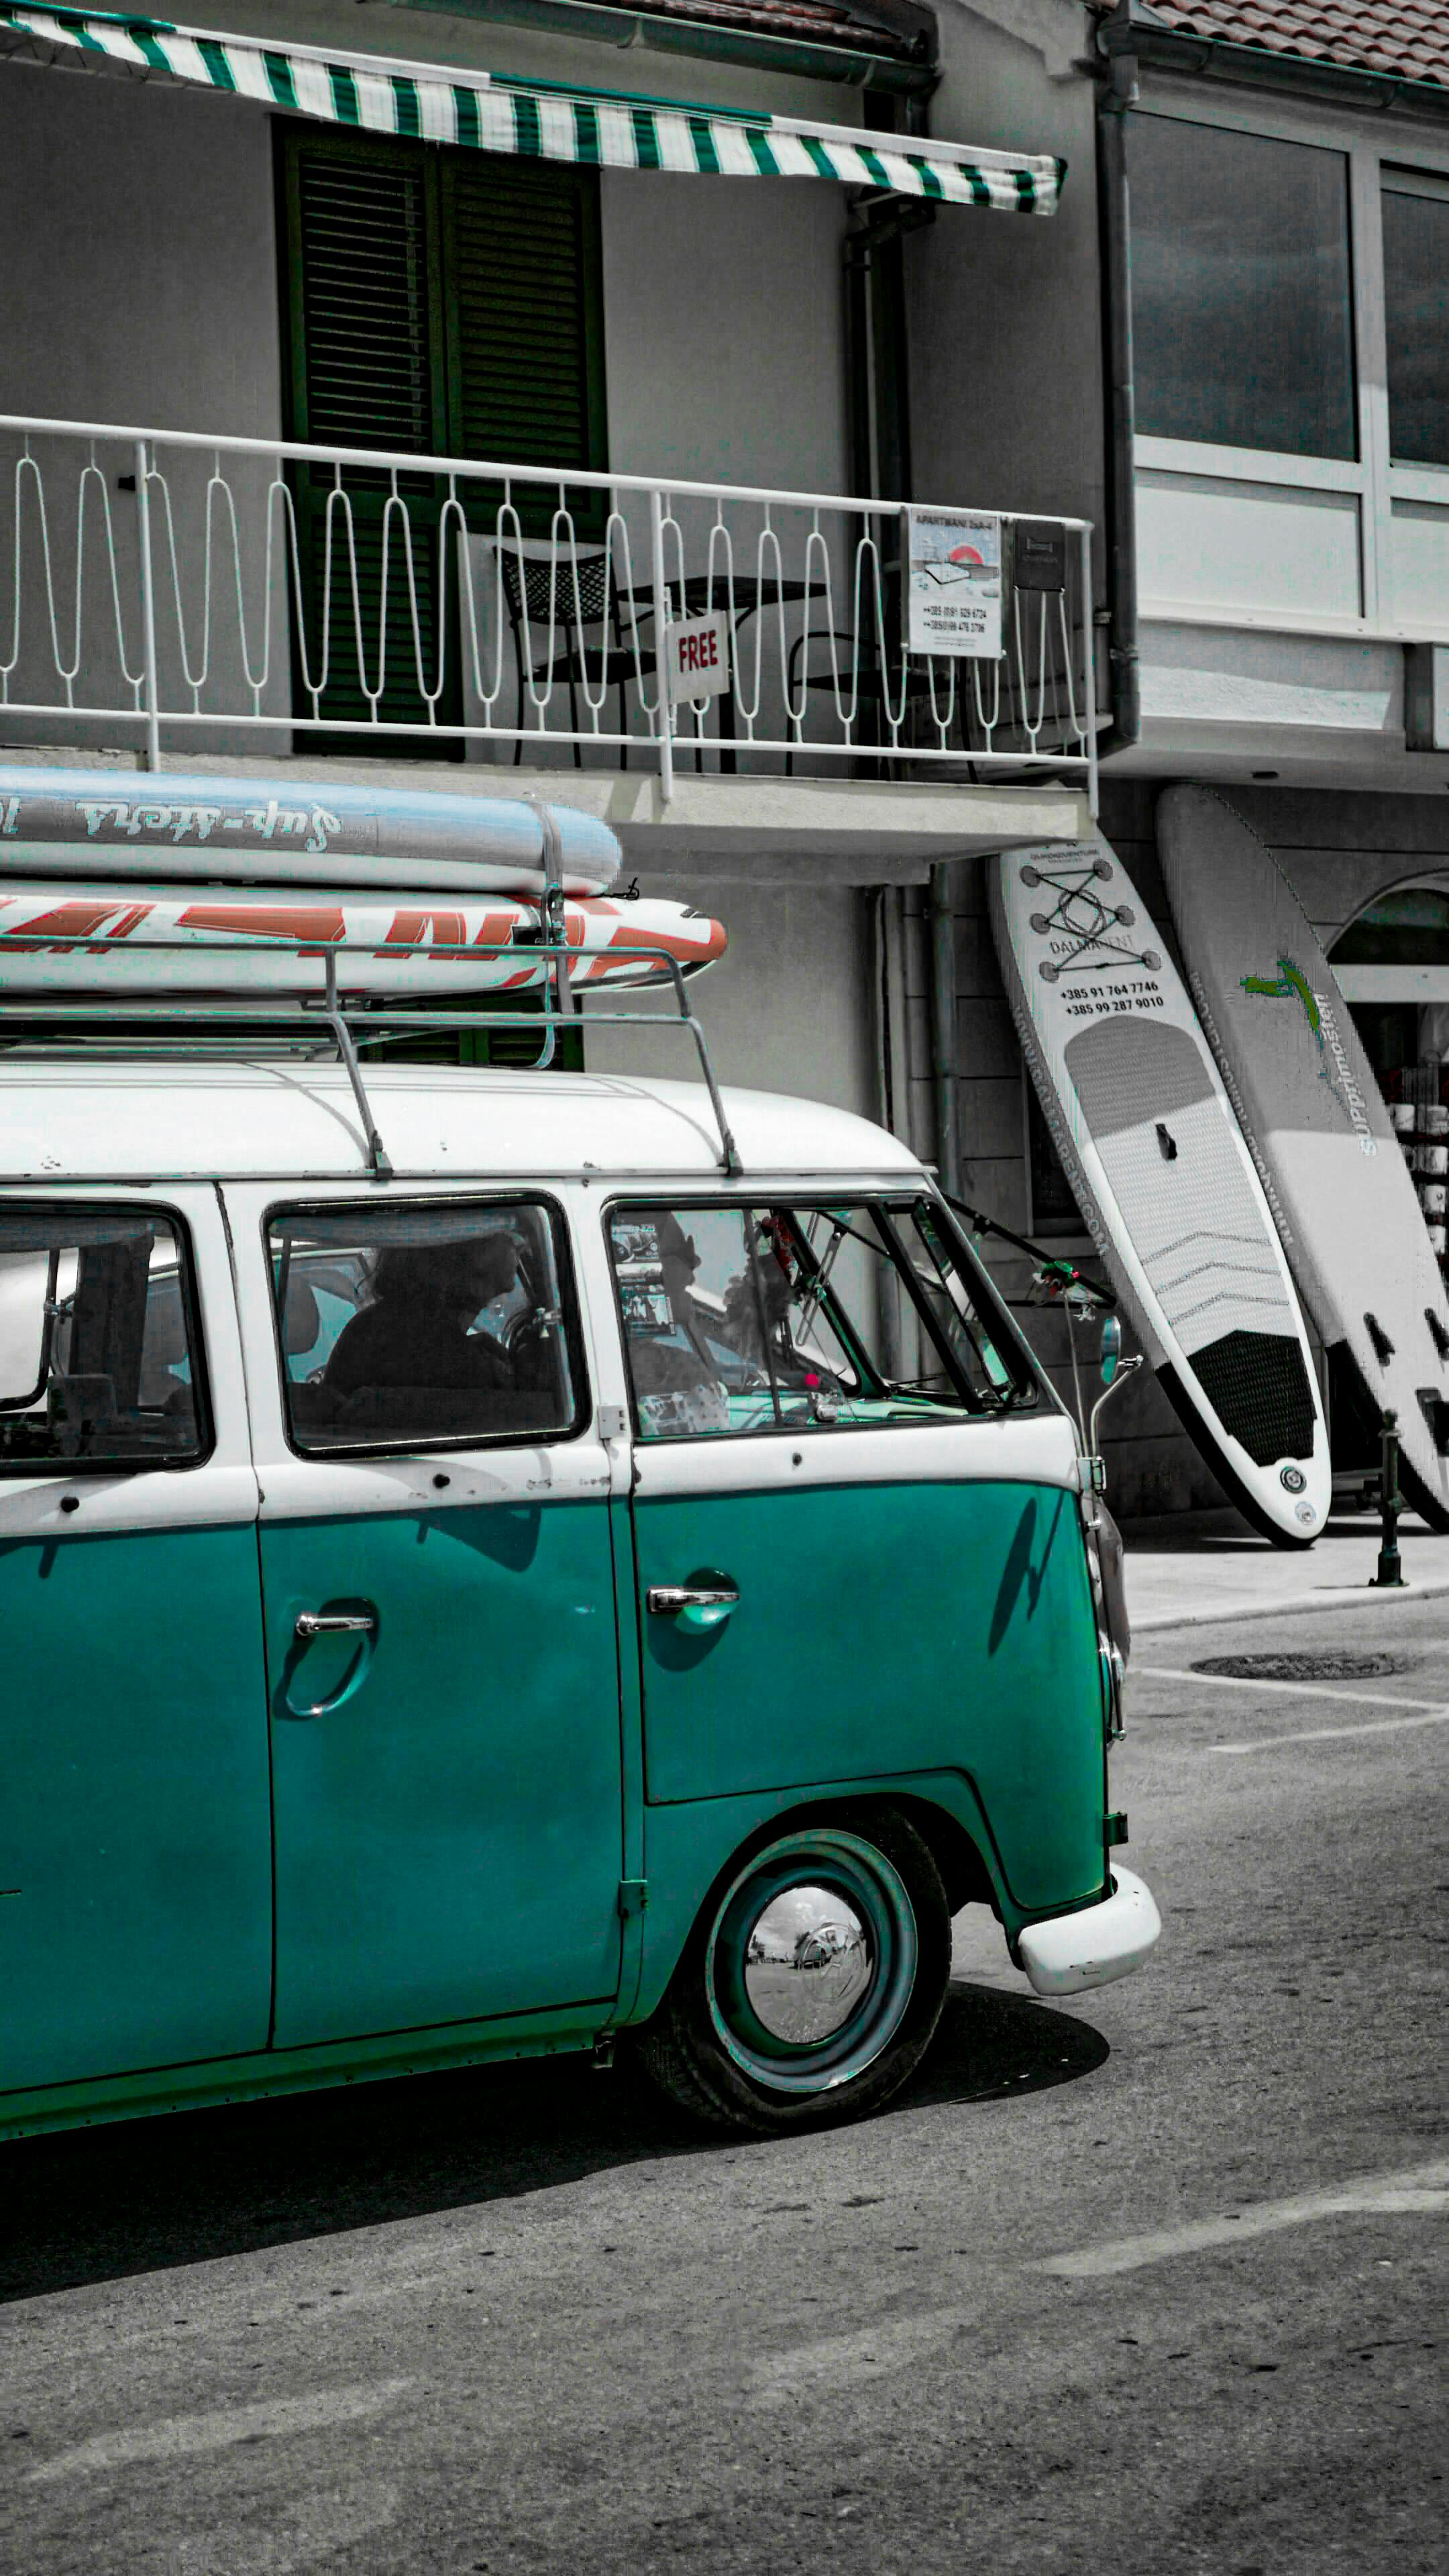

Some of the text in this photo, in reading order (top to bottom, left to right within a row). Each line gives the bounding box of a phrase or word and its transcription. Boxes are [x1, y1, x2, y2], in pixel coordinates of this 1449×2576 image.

[679, 629, 718, 674] FREE
[1060, 980, 1159, 1000] +385 91 764 7746
[1065, 996, 1165, 1016] +385 99 287 9010
